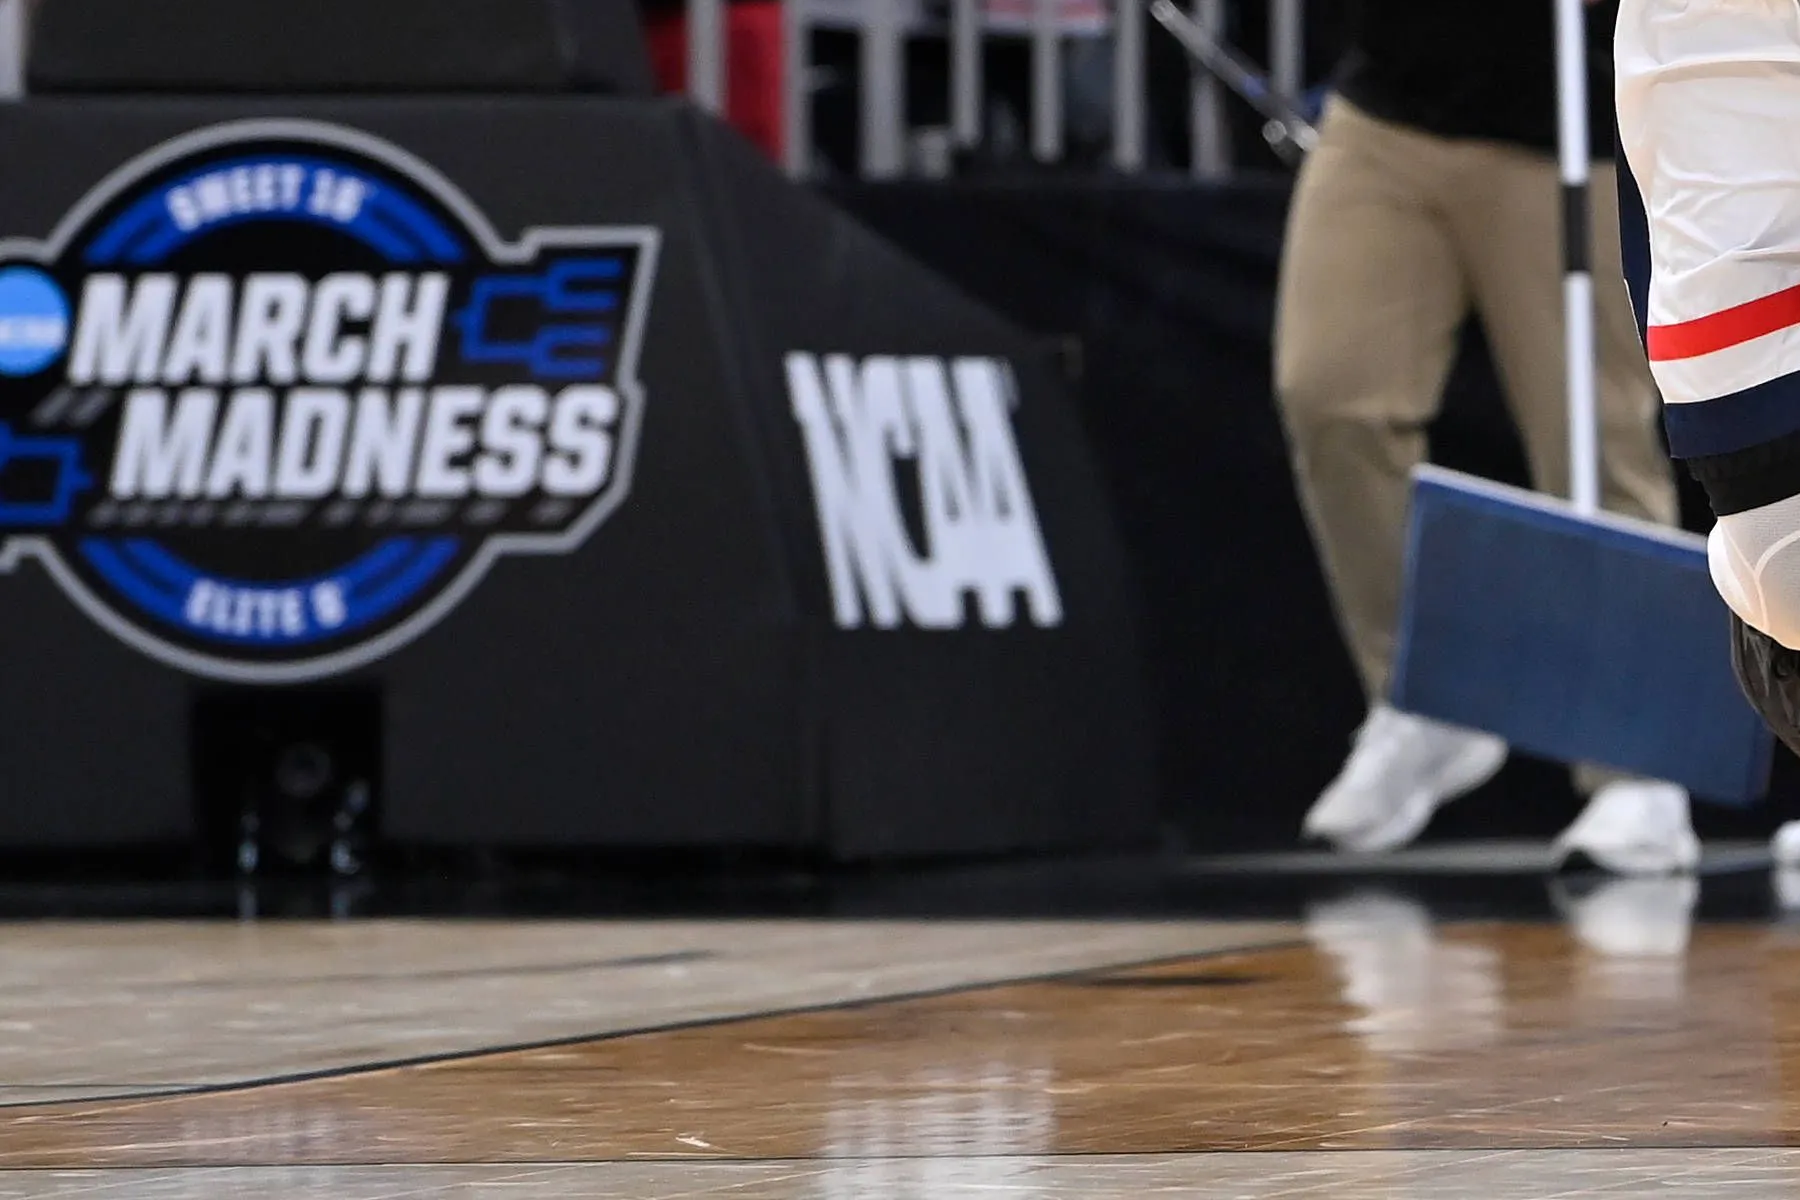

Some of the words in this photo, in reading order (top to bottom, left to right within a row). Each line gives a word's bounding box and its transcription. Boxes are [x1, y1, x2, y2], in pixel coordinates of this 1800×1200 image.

[165, 162, 305, 232] SWEET
[67, 272, 450, 387] MARCH
[108, 383, 621, 500] MADNESS
[783, 349, 1064, 630] NCAA
